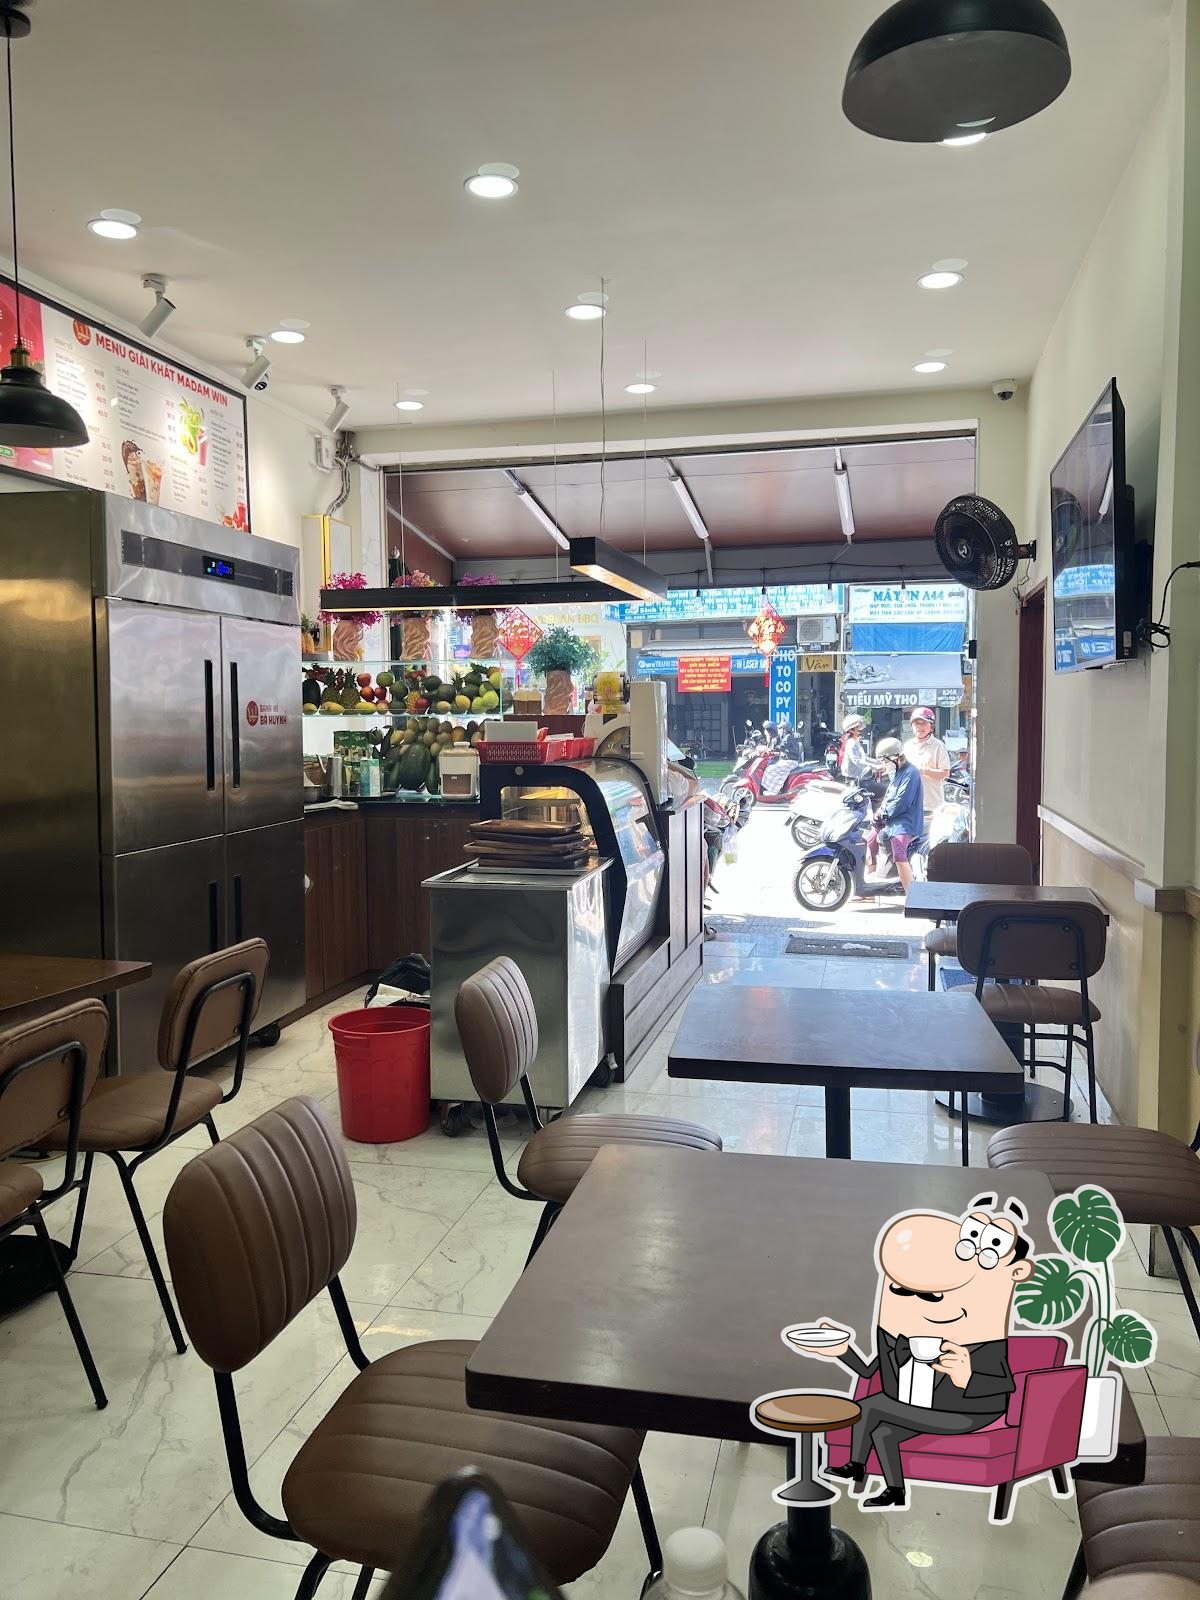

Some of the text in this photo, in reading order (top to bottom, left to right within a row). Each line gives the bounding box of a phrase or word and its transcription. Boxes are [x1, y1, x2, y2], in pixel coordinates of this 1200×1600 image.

[96, 333, 126, 358] MENU
[151, 360, 175, 382] KHÁT
[177, 373, 210, 398] MADAM
[211, 389, 229, 407] WIN
[776, 665, 791, 677] TO
[776, 681, 791, 693] CO
[776, 697, 791, 708] PY
[873, 691, 893, 706] MỸ
[894, 694, 918, 706] THO
[776, 712, 790, 724] IN
